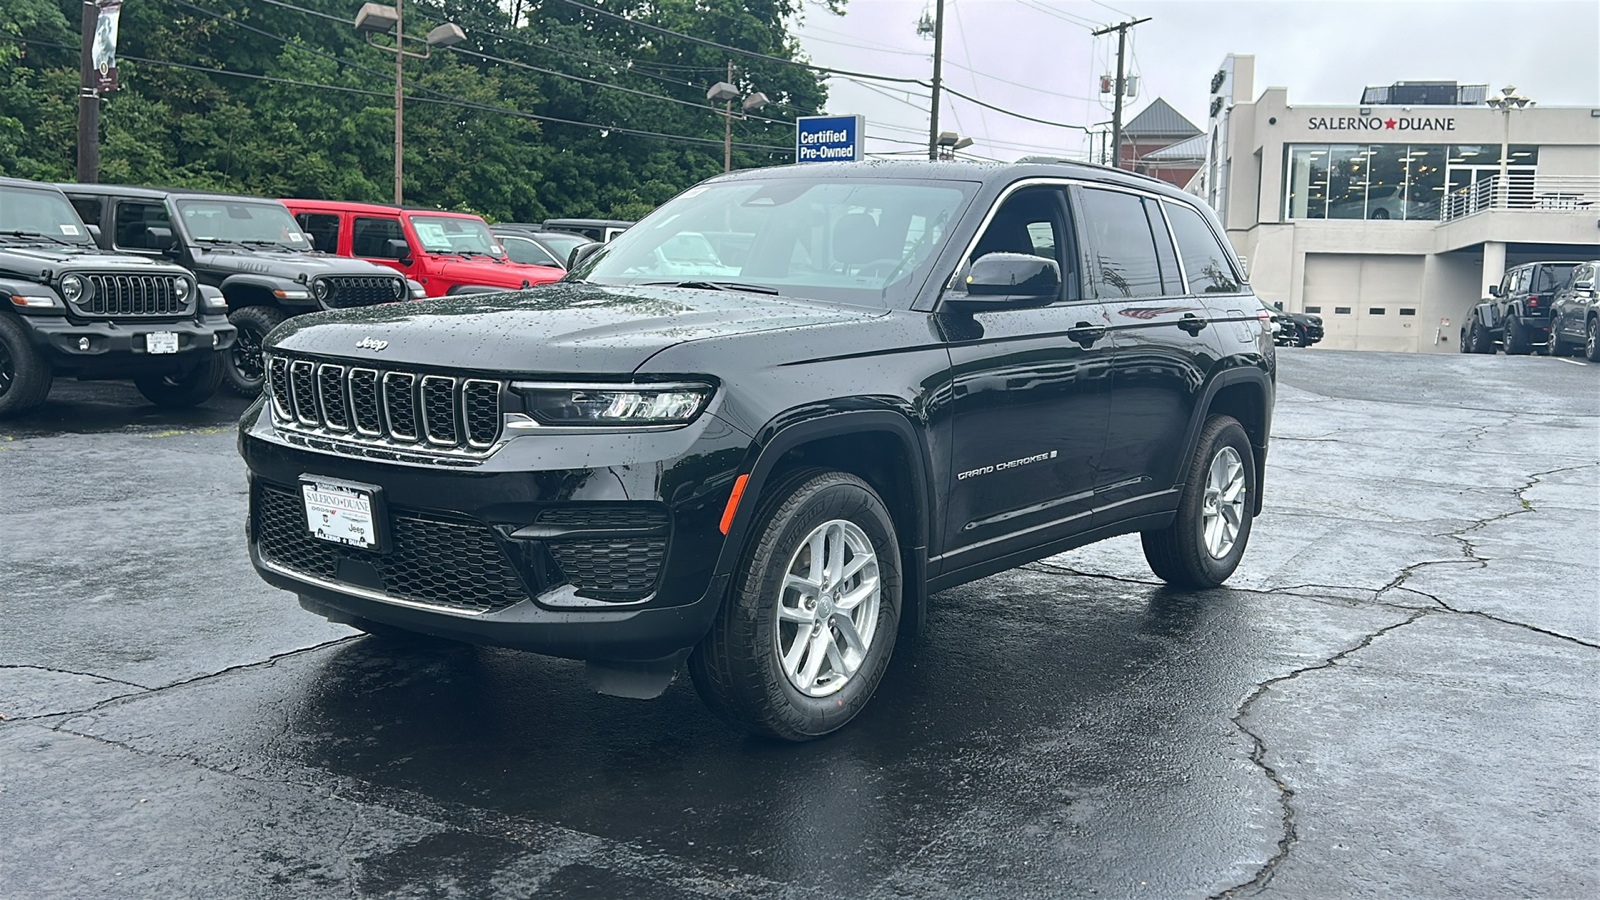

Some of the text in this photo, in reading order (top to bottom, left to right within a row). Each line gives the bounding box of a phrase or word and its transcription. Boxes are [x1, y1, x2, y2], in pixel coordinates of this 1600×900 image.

[1308, 117, 1455, 130] SALERNO DUANE
[801, 130, 846, 143] Certified
[801, 145, 853, 158] Pre-Owned
[237, 261, 272, 273] WILLYS
[355, 336, 389, 352] Jeep
[957, 452, 1049, 480] GRAND CHEROKEE
[306, 492, 369, 512] SALERNO DUANE
[348, 524, 364, 535] Jeep
